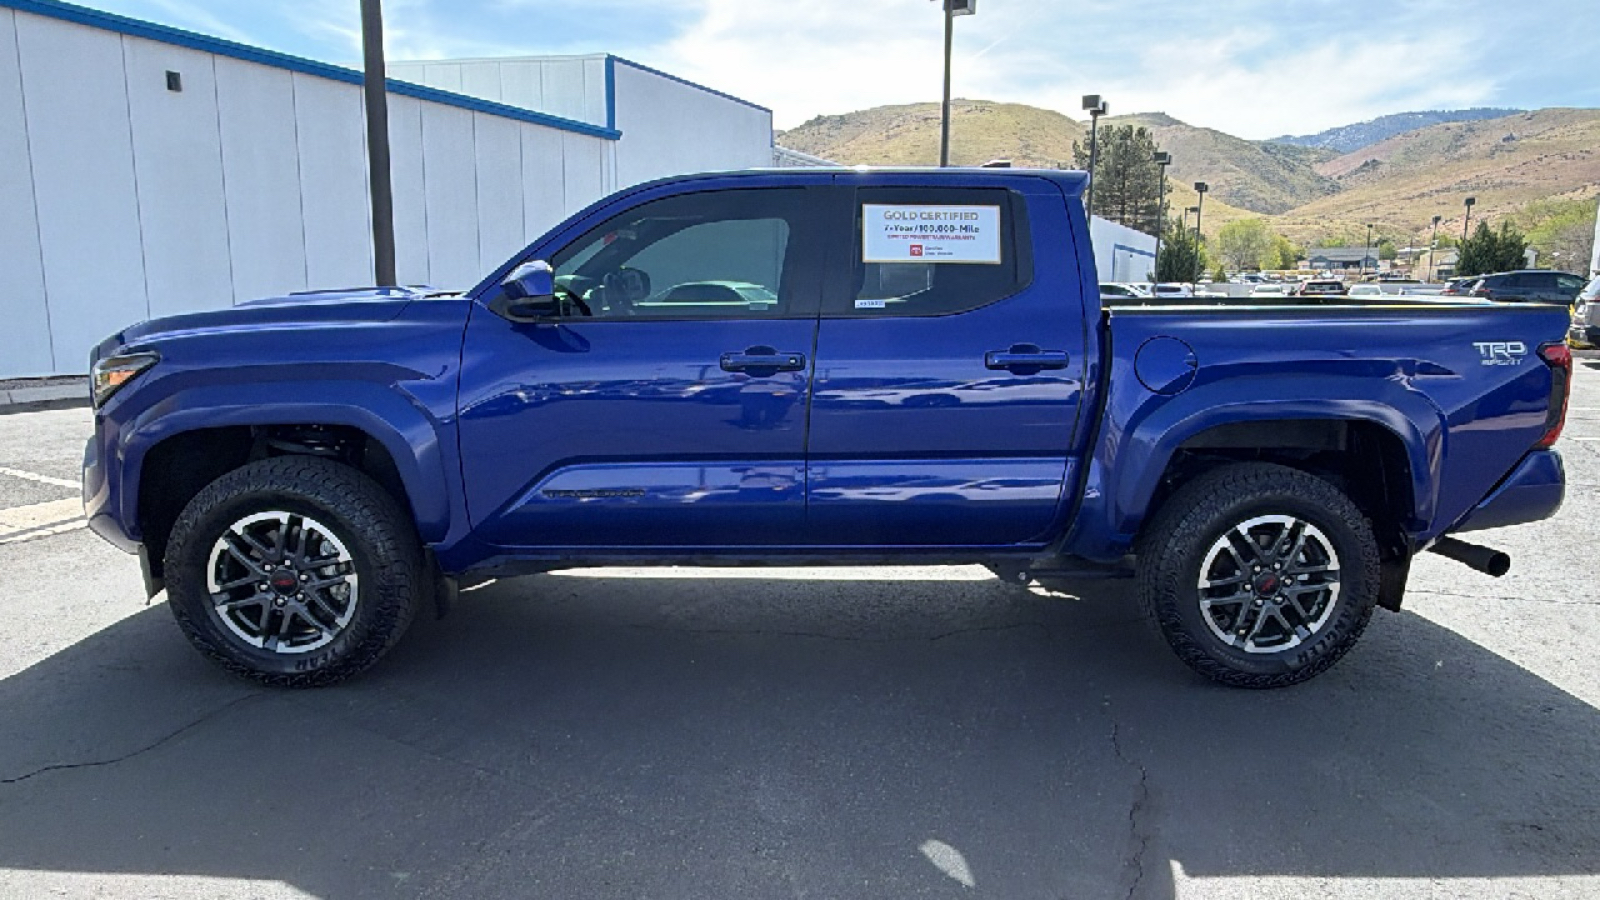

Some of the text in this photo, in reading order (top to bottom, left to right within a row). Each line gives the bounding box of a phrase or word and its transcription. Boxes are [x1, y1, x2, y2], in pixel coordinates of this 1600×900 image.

[884, 211, 979, 220] GOLD CERTIFIED
[1472, 342, 1527, 357] TRD
